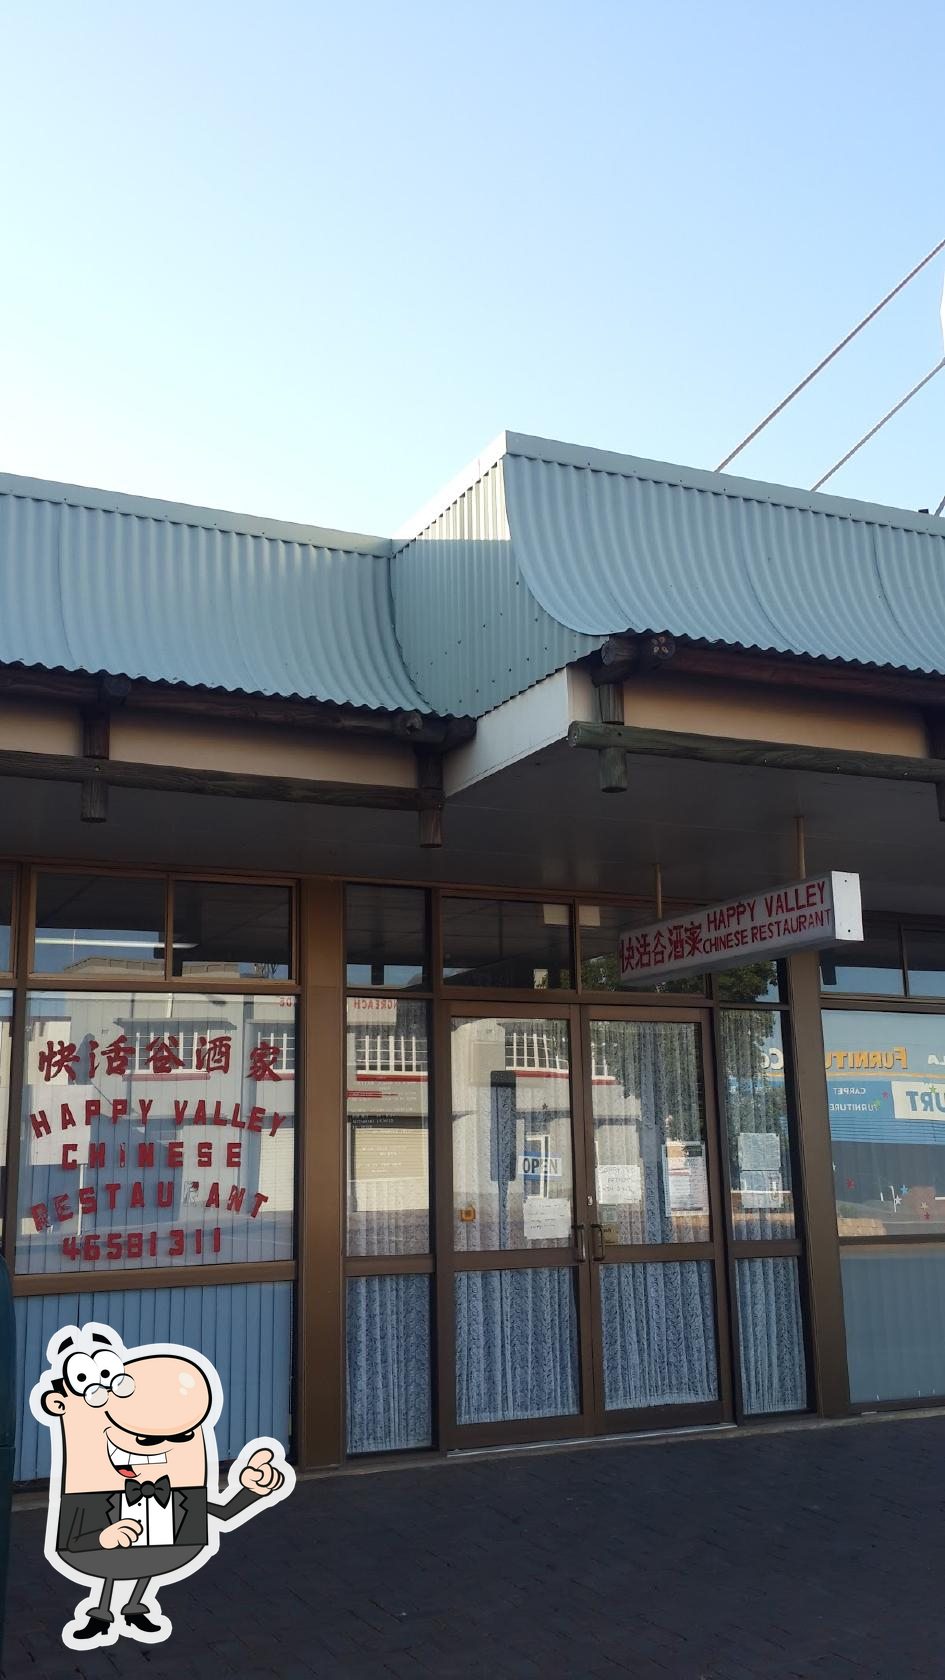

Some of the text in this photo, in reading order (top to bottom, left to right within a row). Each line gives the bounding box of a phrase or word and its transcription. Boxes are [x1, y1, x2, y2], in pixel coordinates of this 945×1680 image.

[706, 880, 825, 932] HAPPY VALLEY
[702, 908, 831, 955] CHINESE RESTAURANT
[30, 1099, 287, 1139] HAPPY VALLEY
[62, 1141, 242, 1170] CHINESE
[523, 1158, 558, 1174] OPEN
